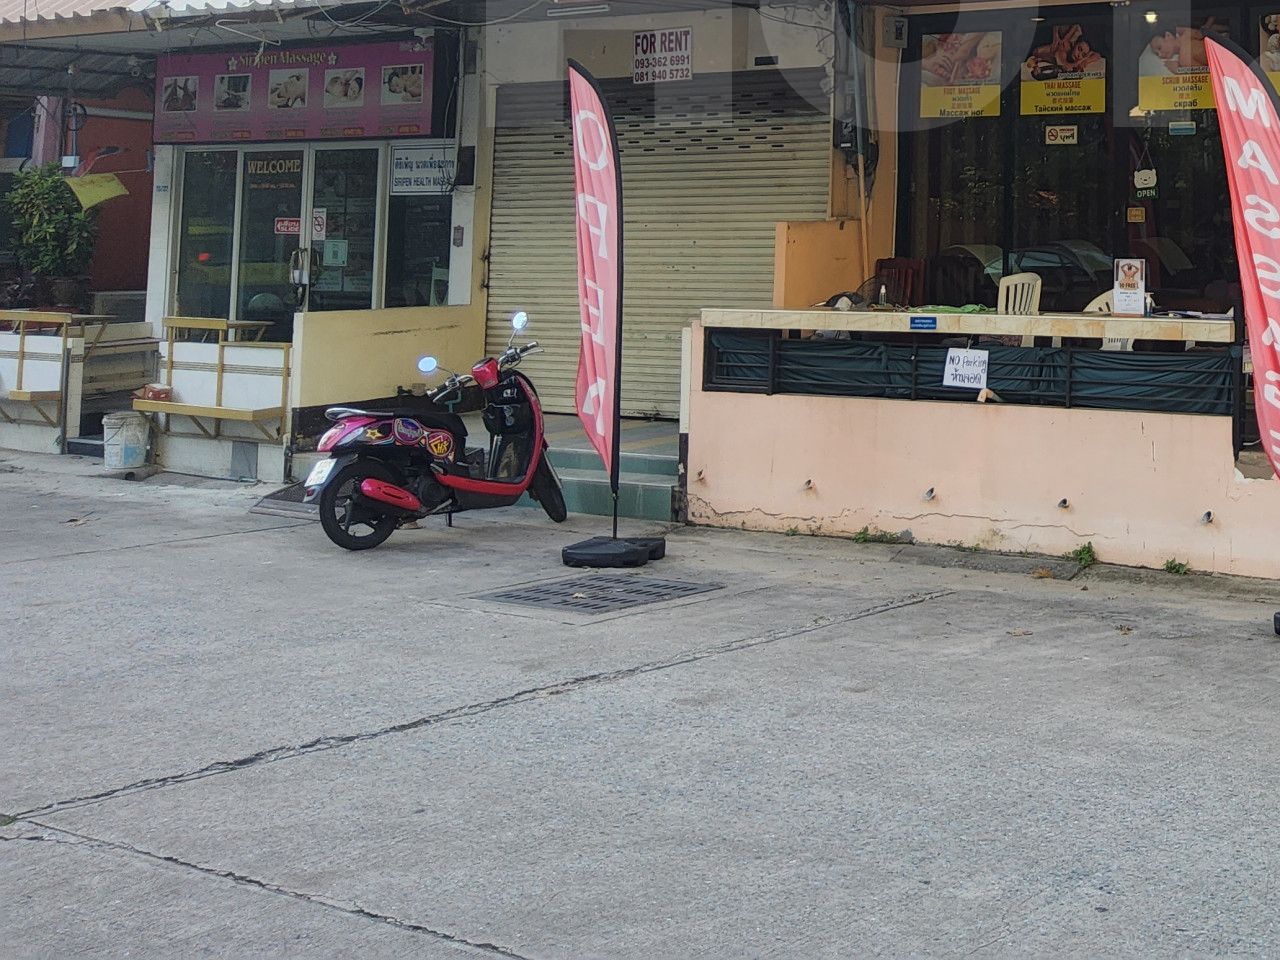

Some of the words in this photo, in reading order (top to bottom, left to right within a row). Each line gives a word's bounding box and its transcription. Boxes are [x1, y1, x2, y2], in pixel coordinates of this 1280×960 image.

[635, 33, 657, 56] FOR
[660, 30, 690, 53] RENT
[635, 56, 668, 69] 093-362
[670, 54, 690, 66] 6991
[634, 71, 649, 82] 081
[651, 69, 667, 81] 940
[669, 68, 690, 80] 5732
[1182, 75, 1209, 84] MASSAGE
[1044, 82, 1056, 90] THAI
[1057, 81, 1081, 89] MASSAGE
[958, 87, 981, 95] MASSAGE
[1174, 99, 1198, 108] скраб
[1034, 104, 1064, 113] Тайский
[1065, 104, 1092, 112] массаж
[248, 159, 301, 174] WELCOME
[413, 176, 432, 186] HEALTH
[1136, 189, 1156, 198] OPEN
[949, 355, 961, 366] NO
